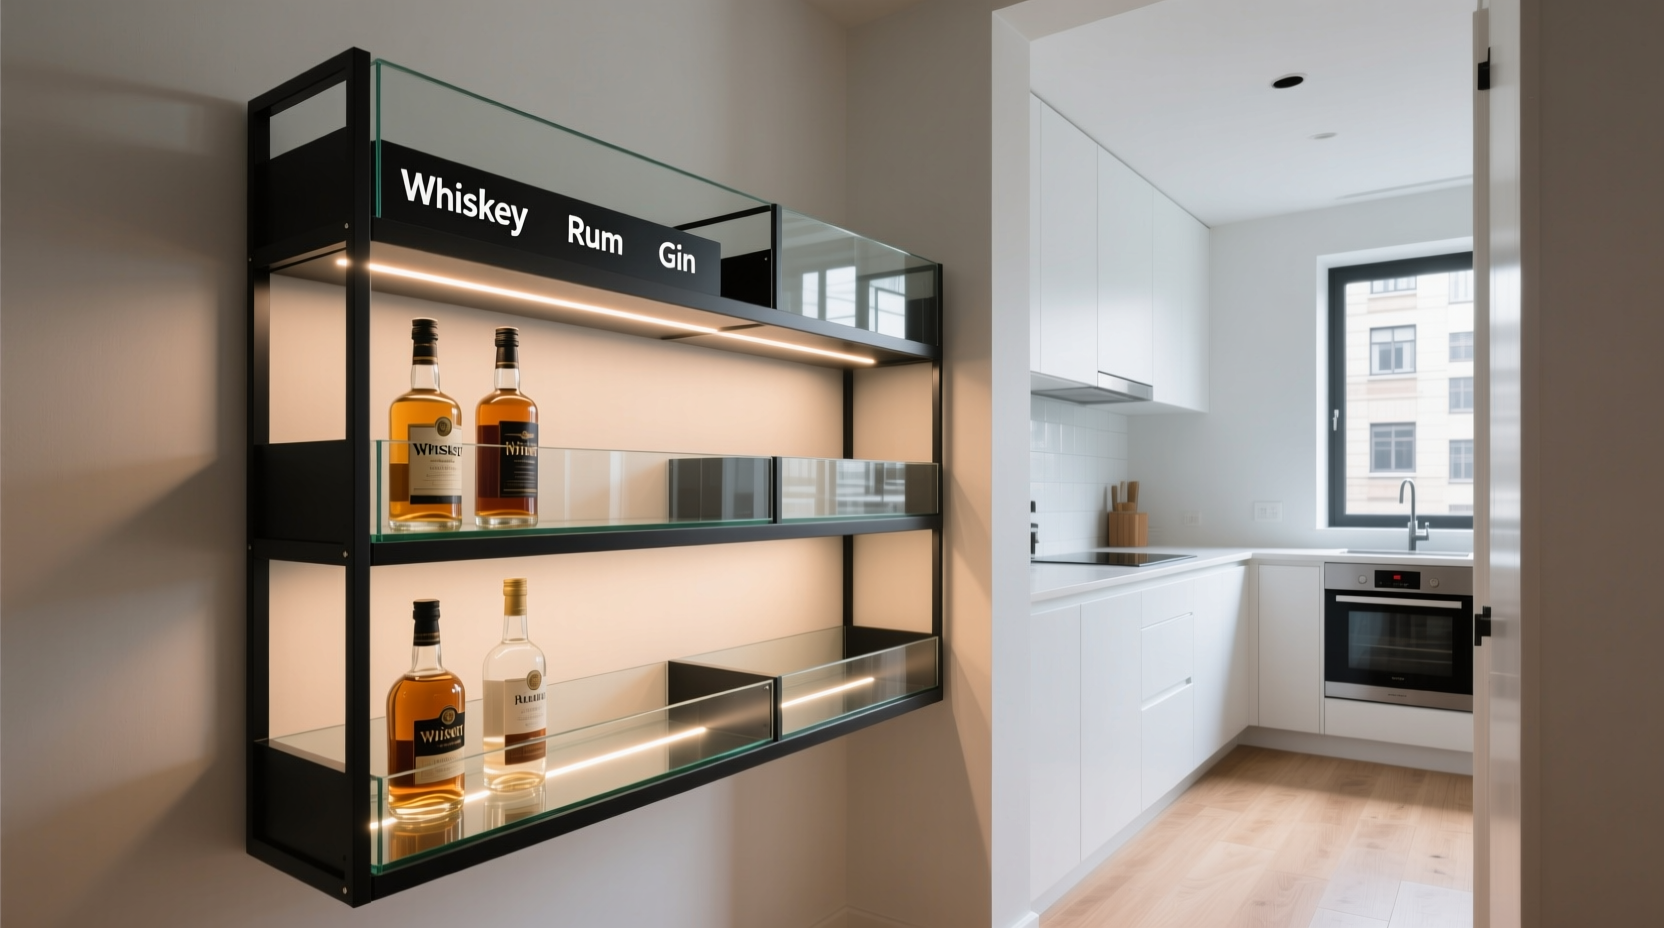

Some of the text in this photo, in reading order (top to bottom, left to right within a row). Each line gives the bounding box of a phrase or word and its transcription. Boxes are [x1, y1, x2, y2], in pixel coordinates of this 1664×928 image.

[401, 168, 696, 274] Whiskey Rum Gin
